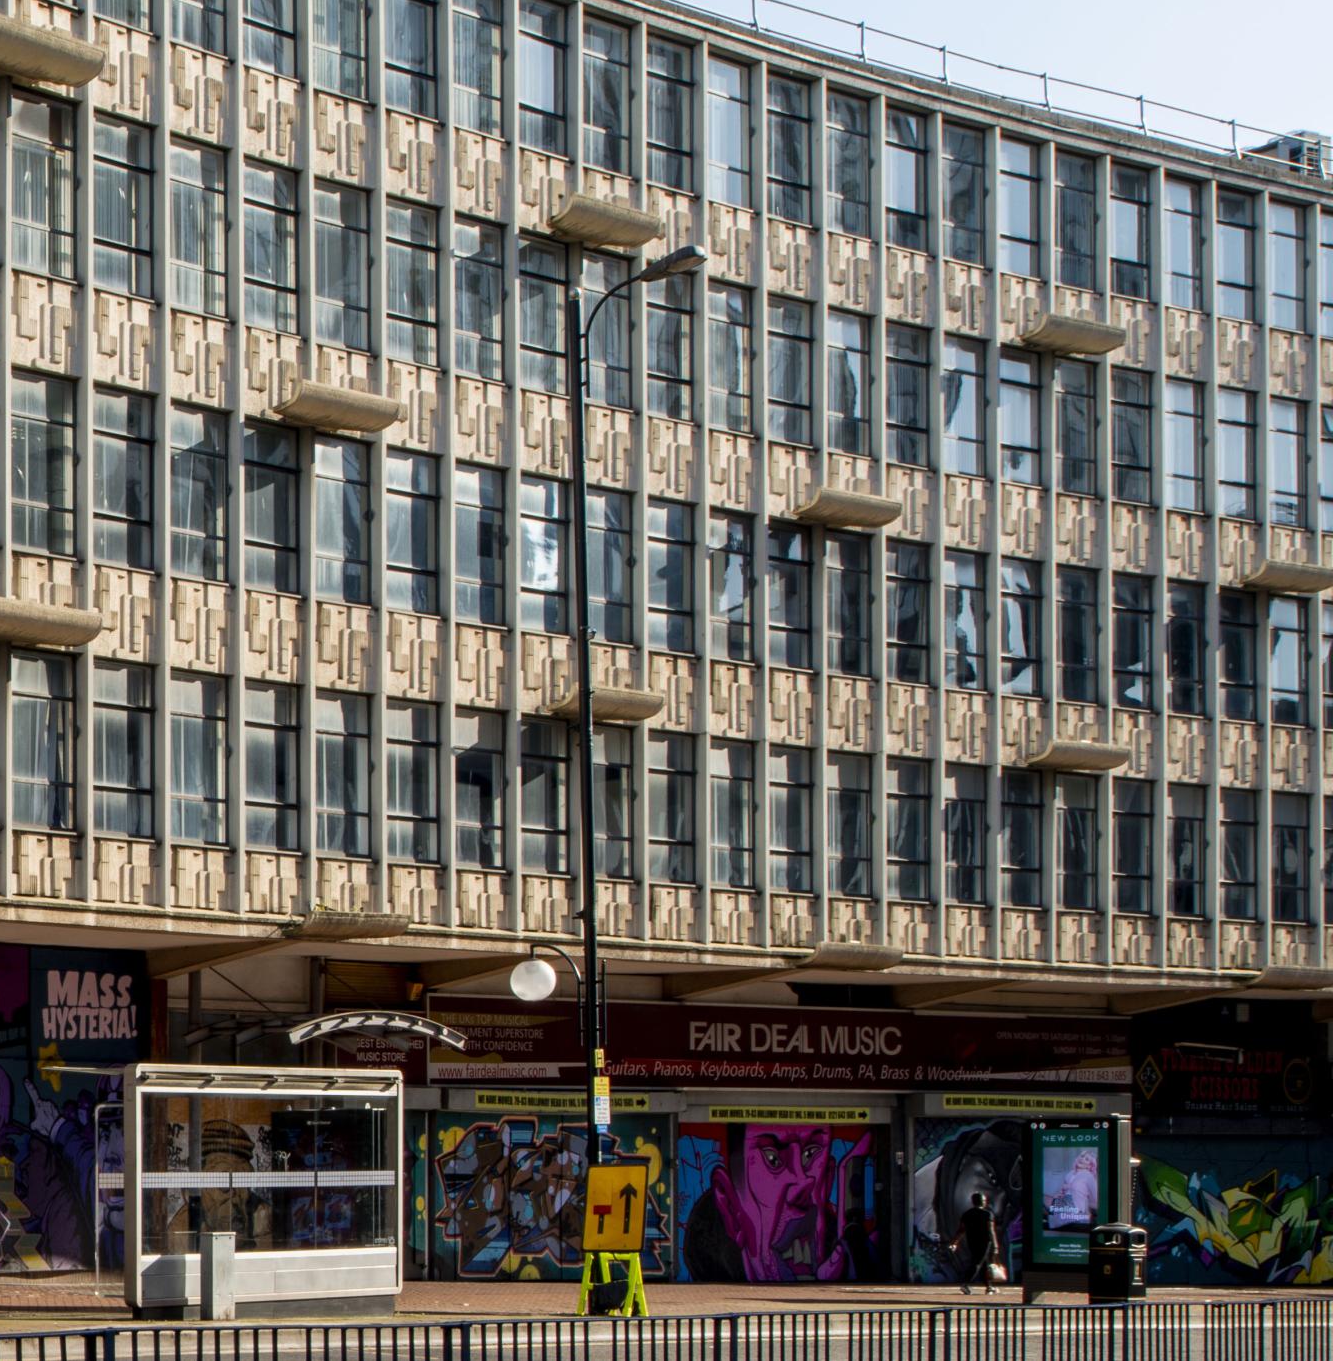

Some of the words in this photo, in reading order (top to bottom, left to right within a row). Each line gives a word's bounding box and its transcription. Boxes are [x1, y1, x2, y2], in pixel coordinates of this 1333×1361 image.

[47, 970, 132, 1007] MASS
[42, 1005, 138, 1040] HYSTERIA!
[495, 1028, 545, 1040] SUPERSTORE
[483, 1041, 534, 1052] CONFIDENCE
[689, 1021, 741, 1052] FAIR
[750, 1023, 814, 1054] DEAL
[820, 1025, 902, 1056] MUSIC
[357, 1051, 381, 1062] MUSIC
[603, 1060, 649, 1078] Guitars,
[653, 1060, 695, 1078] Pianos,
[699, 1060, 766, 1081] Keyboards,
[770, 1062, 808, 1082] Amps,
[813, 1063, 854, 1081] Drums,
[858, 1064, 876, 1081] PA,
[881, 1064, 910, 1080] Brass
[914, 1066, 925, 1081] &
[928, 1066, 993, 1082] Woodwind
[1190, 1075, 1262, 1101] SCISSORS
